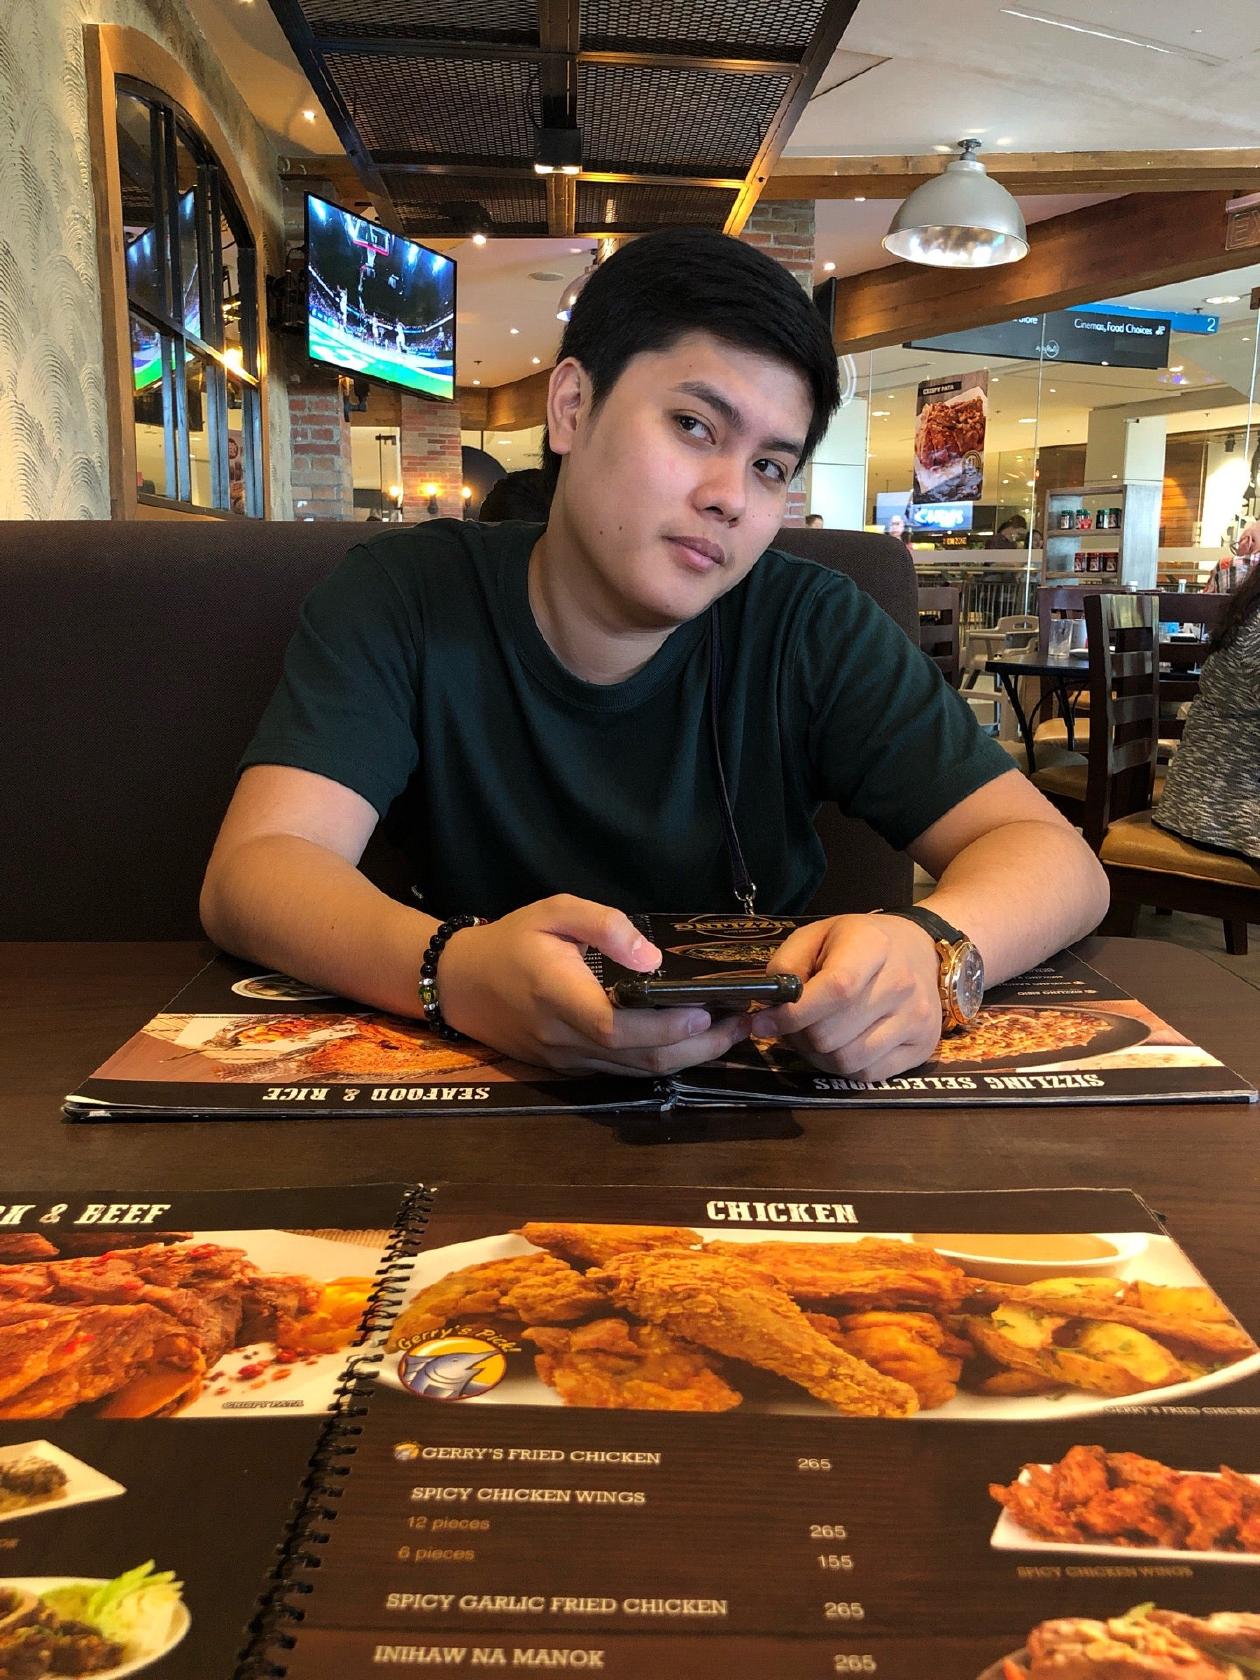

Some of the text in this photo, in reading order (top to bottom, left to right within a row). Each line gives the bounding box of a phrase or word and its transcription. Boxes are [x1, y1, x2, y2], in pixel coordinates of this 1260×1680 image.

[1106, 321, 1125, 333] Food
[1125, 323, 1153, 336] Choices
[1207, 317, 1216, 332] 2
[815, 1074, 1106, 1091] SIZZLING SELECTIONS
[262, 1087, 491, 1101] SEAFOOD & RICE
[39, 1203, 69, 1224] &
[73, 1204, 172, 1225] BEEF
[706, 1200, 860, 1224] CHICKEN
[398, 1324, 473, 1351] Gerry's
[1160, 1406, 1201, 1416] FRIED
[422, 1447, 662, 1465] GERRY'S FRIED CHICKEN
[798, 1458, 832, 1471] 265
[411, 1487, 646, 1504] SPICY CHICKEN WINGS
[407, 1516, 491, 1533] 12 pieces
[809, 1524, 847, 1539] 265
[398, 1545, 476, 1562] 6 pieces
[818, 1554, 854, 1570] 155
[386, 1593, 729, 1616] SPICY GARLIC FRIED CHICKEN
[824, 1601, 865, 1619] 265
[373, 1645, 606, 1669] INIHAW NA MANOK
[834, 1654, 877, 1674] 265
